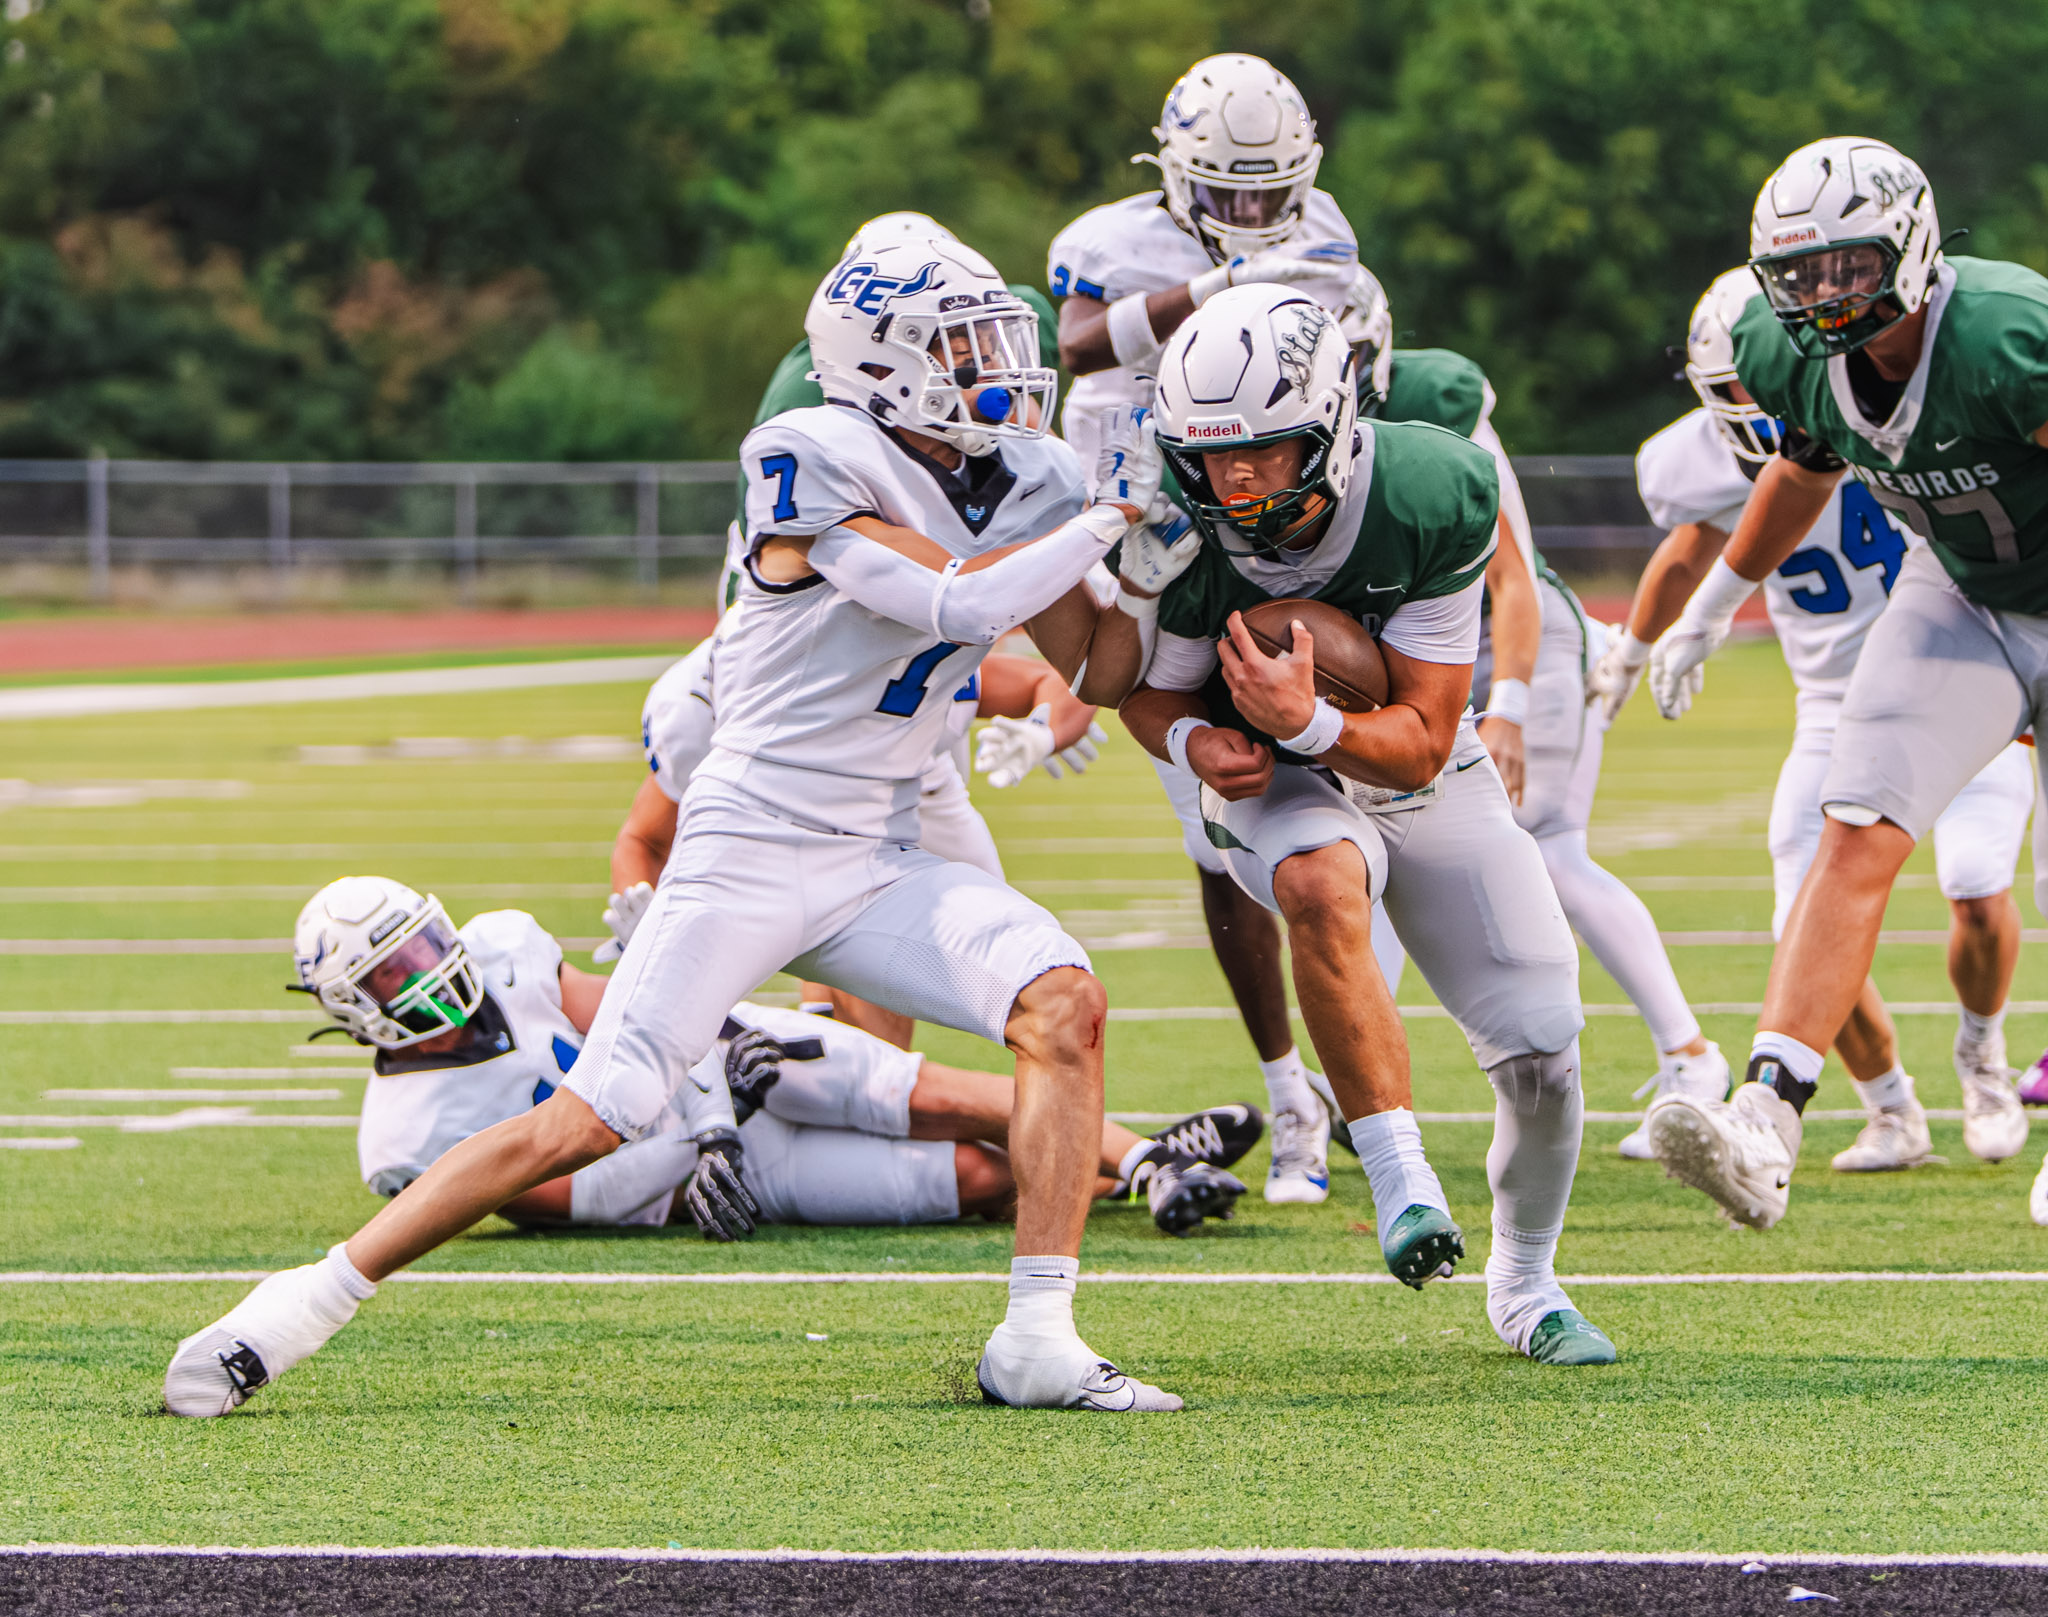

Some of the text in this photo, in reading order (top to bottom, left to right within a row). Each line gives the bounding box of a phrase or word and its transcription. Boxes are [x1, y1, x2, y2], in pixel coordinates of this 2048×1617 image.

[1772, 229, 1817, 246] Riddell
[1187, 423, 1242, 438] Riddell
[760, 453, 799, 524] 7
[1778, 481, 1908, 614] 54
[1869, 486, 2021, 566] 77
